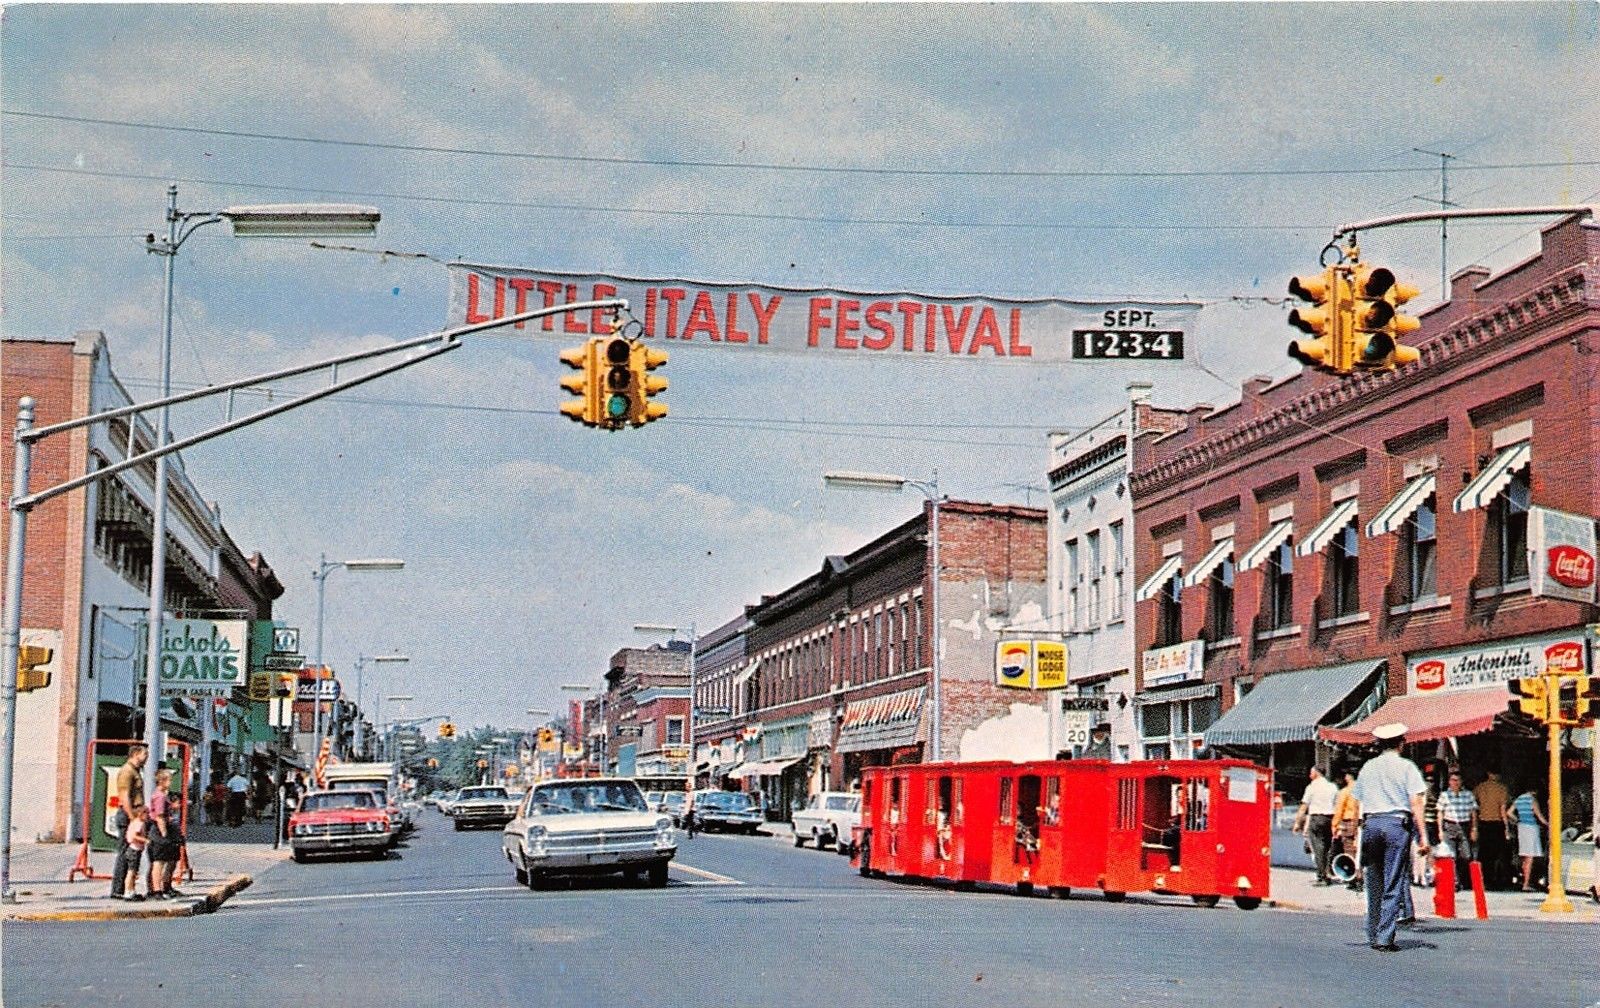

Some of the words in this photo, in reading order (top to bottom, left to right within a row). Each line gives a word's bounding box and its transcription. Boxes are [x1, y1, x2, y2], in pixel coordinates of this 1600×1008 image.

[466, 273, 618, 336] LITTLE
[644, 287, 784, 345] ITALY
[806, 297, 1034, 358] FESTIVAL
[1103, 310, 1157, 328] SEPT.
[144, 623, 240, 653] ichols
[1037, 650, 1065, 661] MOOSE
[143, 655, 239, 680] OANS
[1037, 661, 1065, 673] LODGE
[1067, 729, 1087, 743] 20
